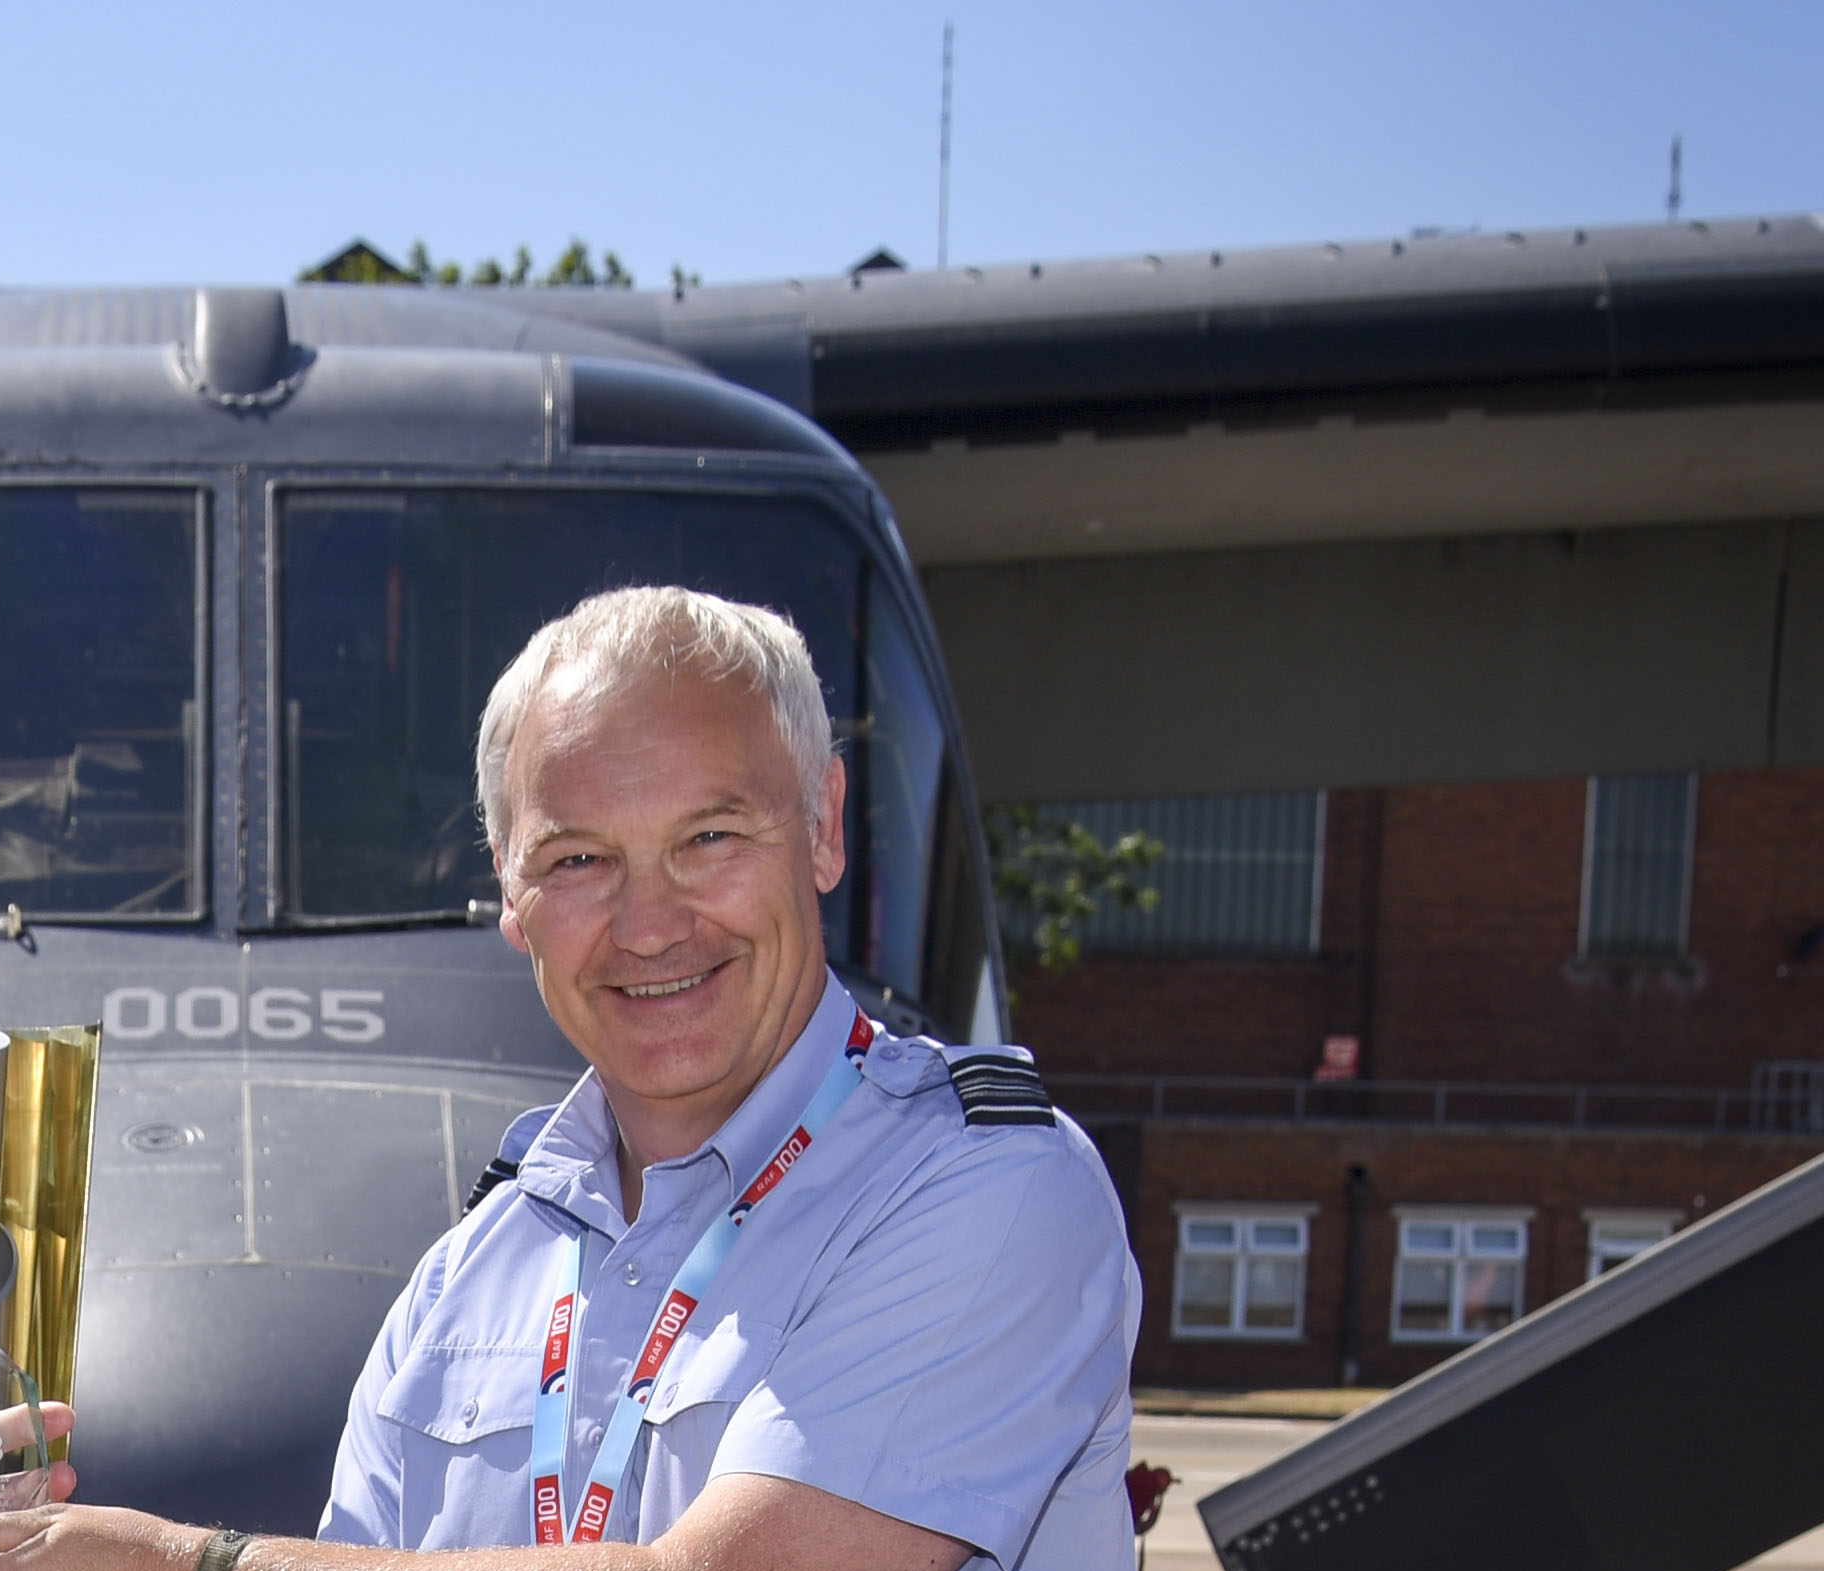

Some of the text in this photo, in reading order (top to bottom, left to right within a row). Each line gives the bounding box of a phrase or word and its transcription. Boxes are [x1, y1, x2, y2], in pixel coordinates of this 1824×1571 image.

[102, 986, 386, 1043] 0065
[757, 1138, 803, 1192] RAF 100
[550, 1303, 571, 1360] RAF 100
[647, 1302, 688, 1365] RAF 100
[537, 1486, 558, 1523] 100
[580, 1495, 607, 1531] 100
